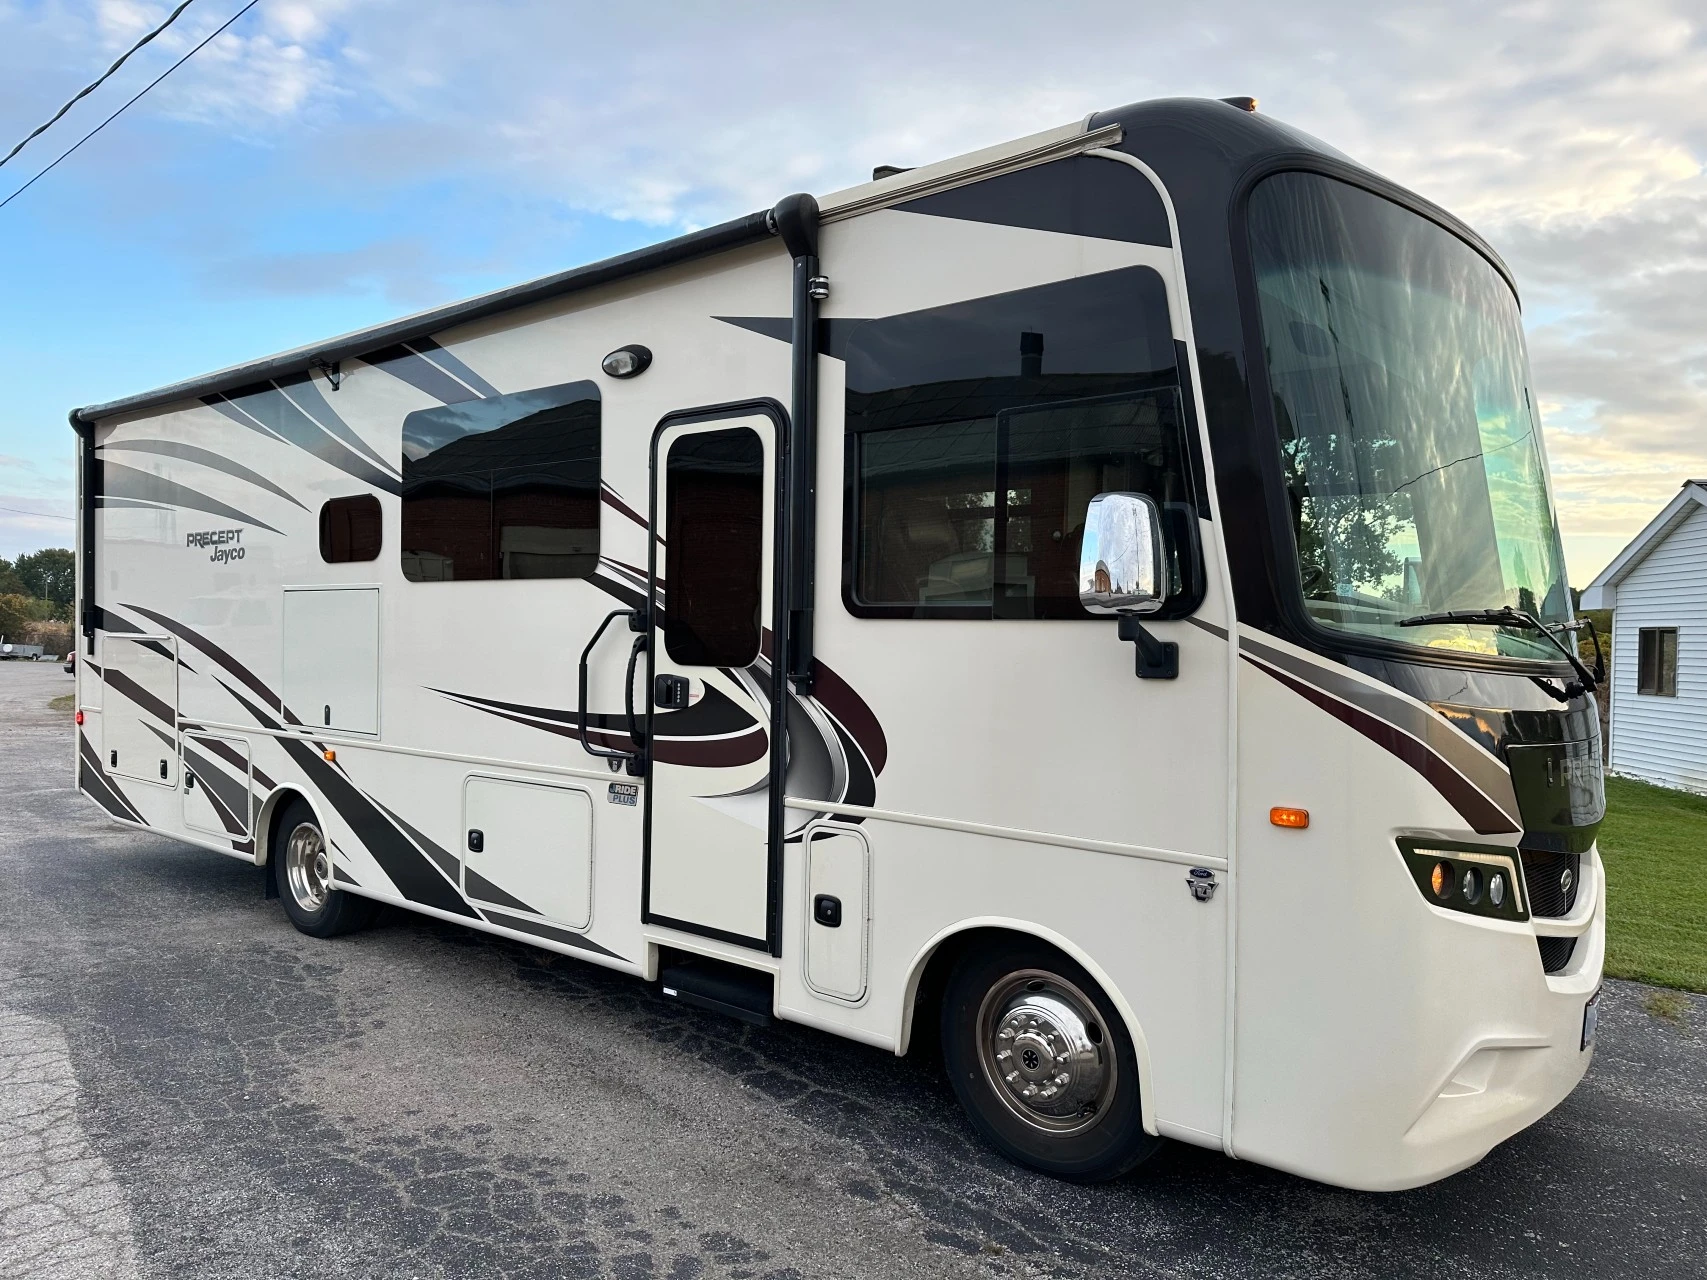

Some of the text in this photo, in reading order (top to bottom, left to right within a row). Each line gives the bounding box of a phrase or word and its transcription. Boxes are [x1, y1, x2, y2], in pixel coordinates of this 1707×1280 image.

[186, 528, 244, 548] PRECEPT
[210, 546, 246, 565] Jayco
[612, 794, 636, 805] PLUS
[1193, 869, 1208, 877] Ford
